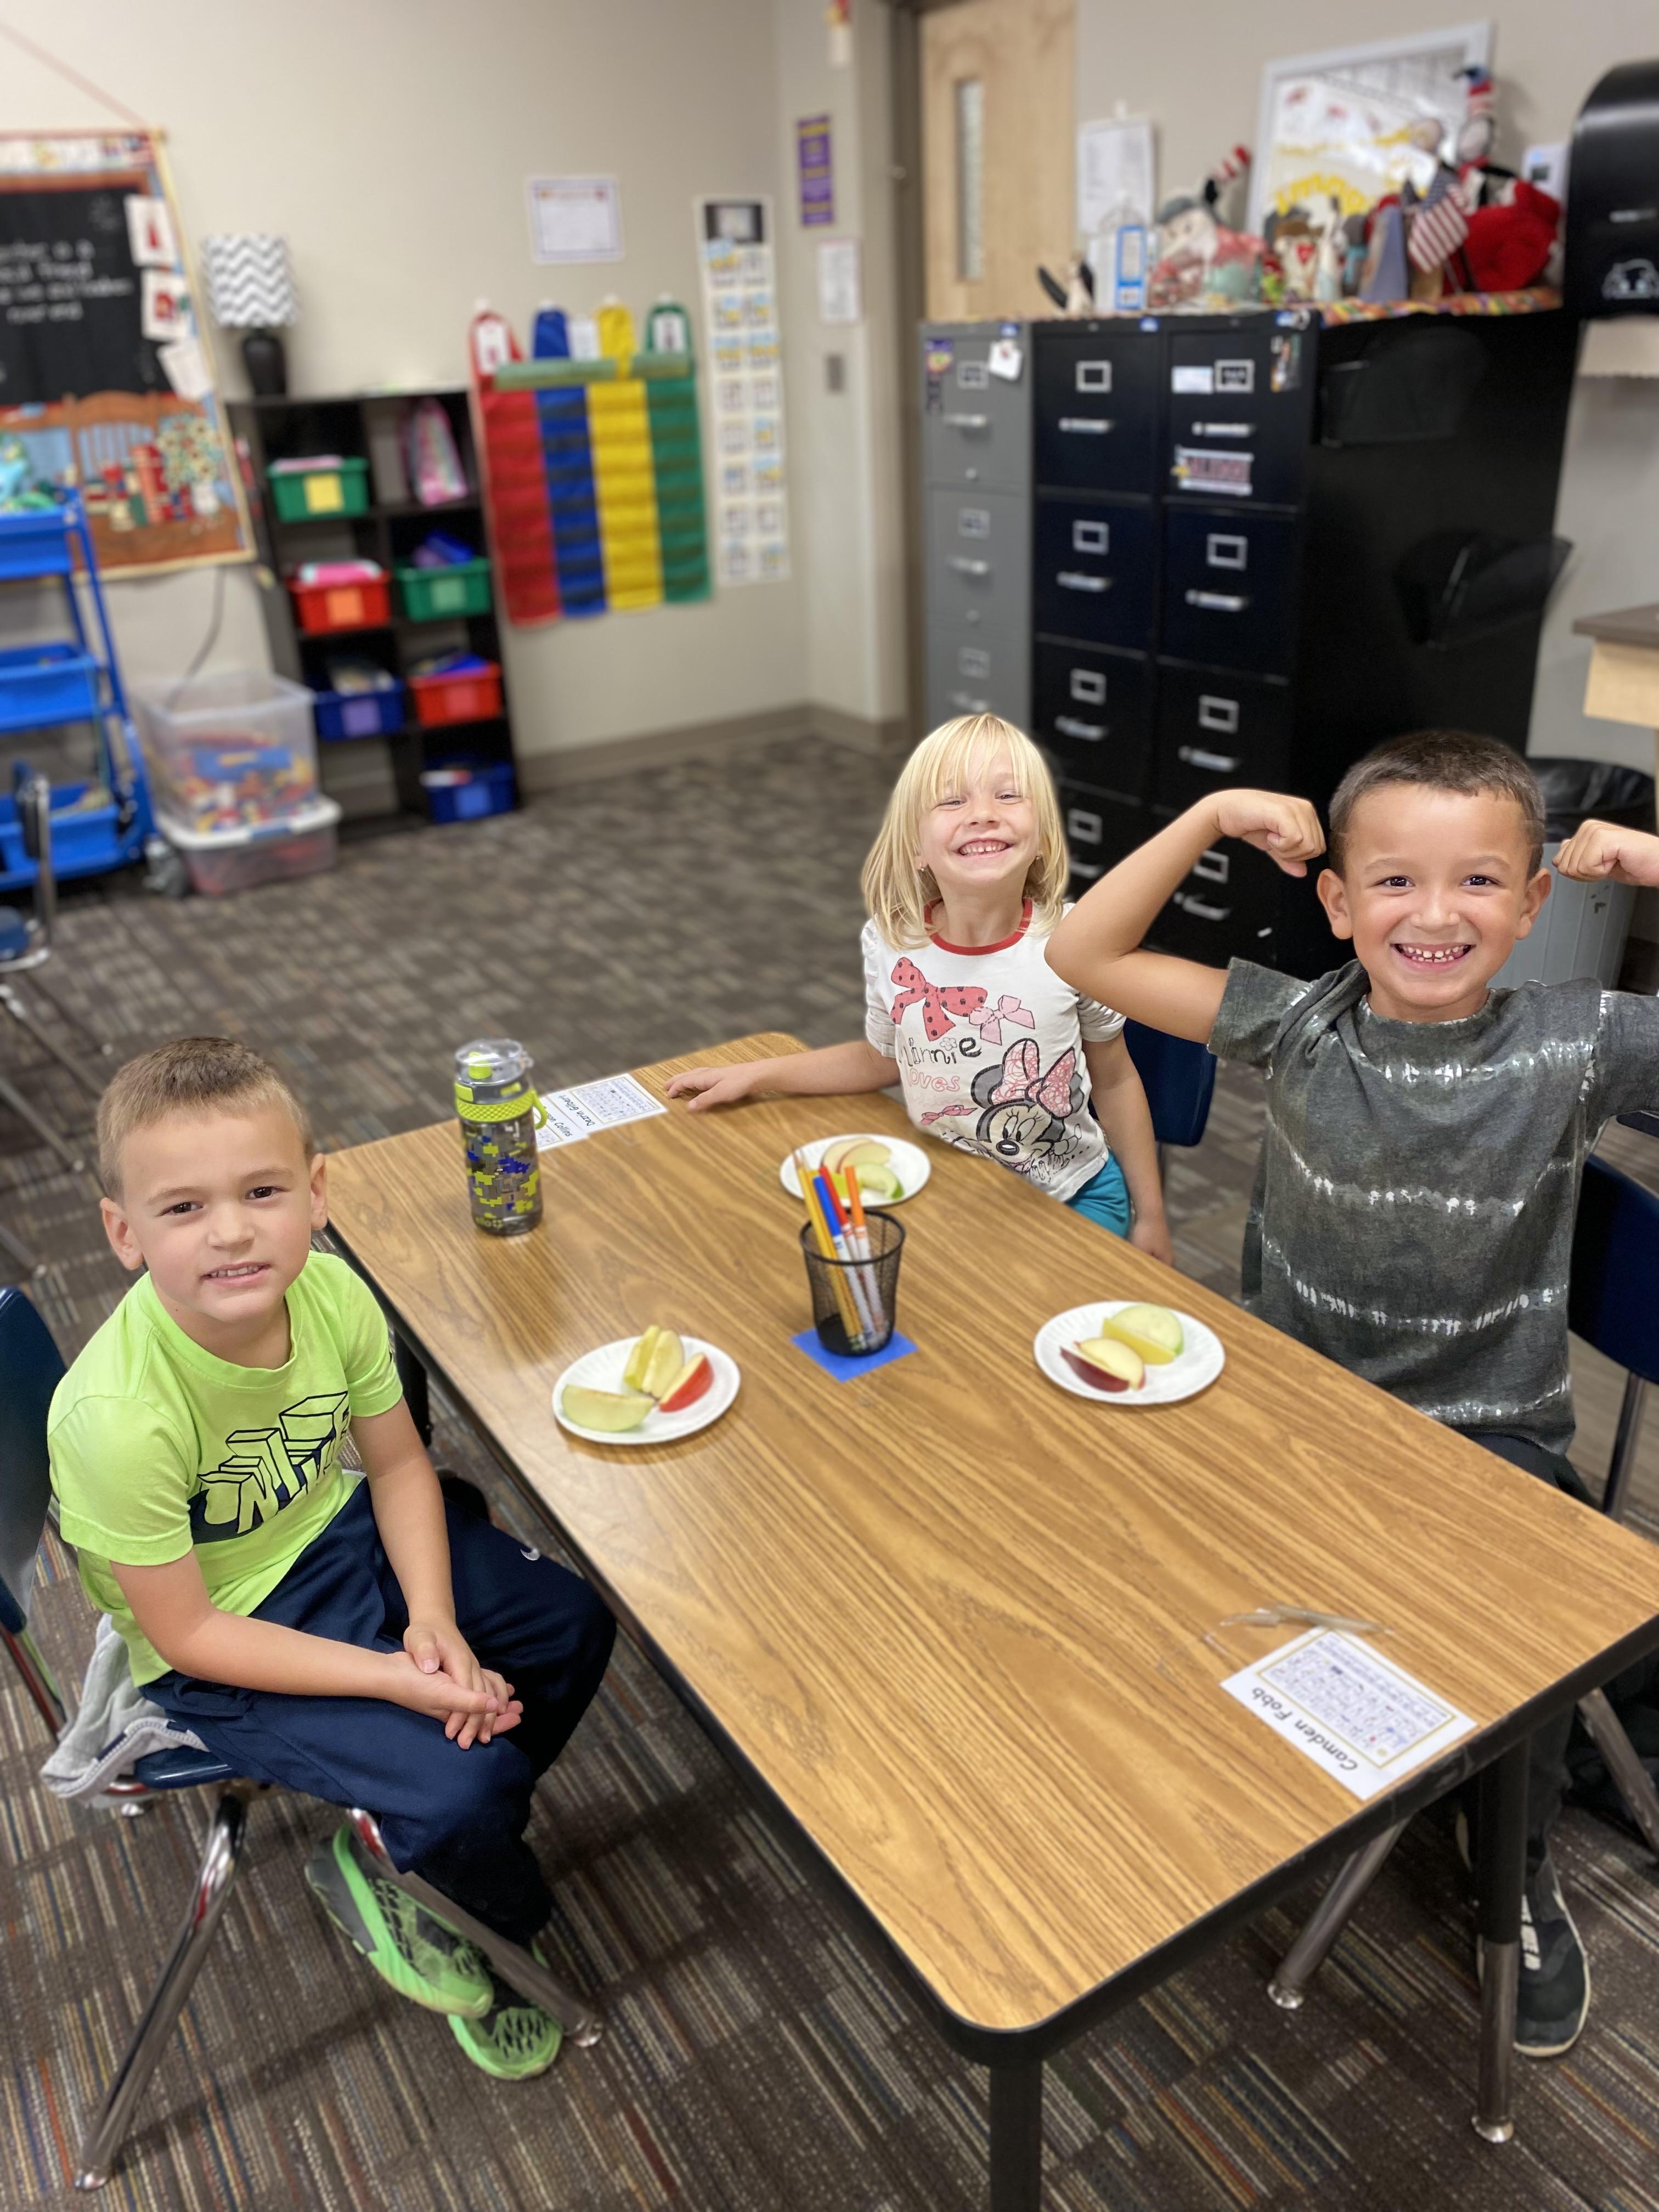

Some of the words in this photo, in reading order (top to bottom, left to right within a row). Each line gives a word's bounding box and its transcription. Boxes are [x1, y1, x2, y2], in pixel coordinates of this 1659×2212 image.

[554, 1122, 573, 1137] Collins
[576, 1110, 596, 1126] Dezrin
[1252, 1686, 1293, 1722] Fobb
[1294, 1719, 1358, 1771] Camden
